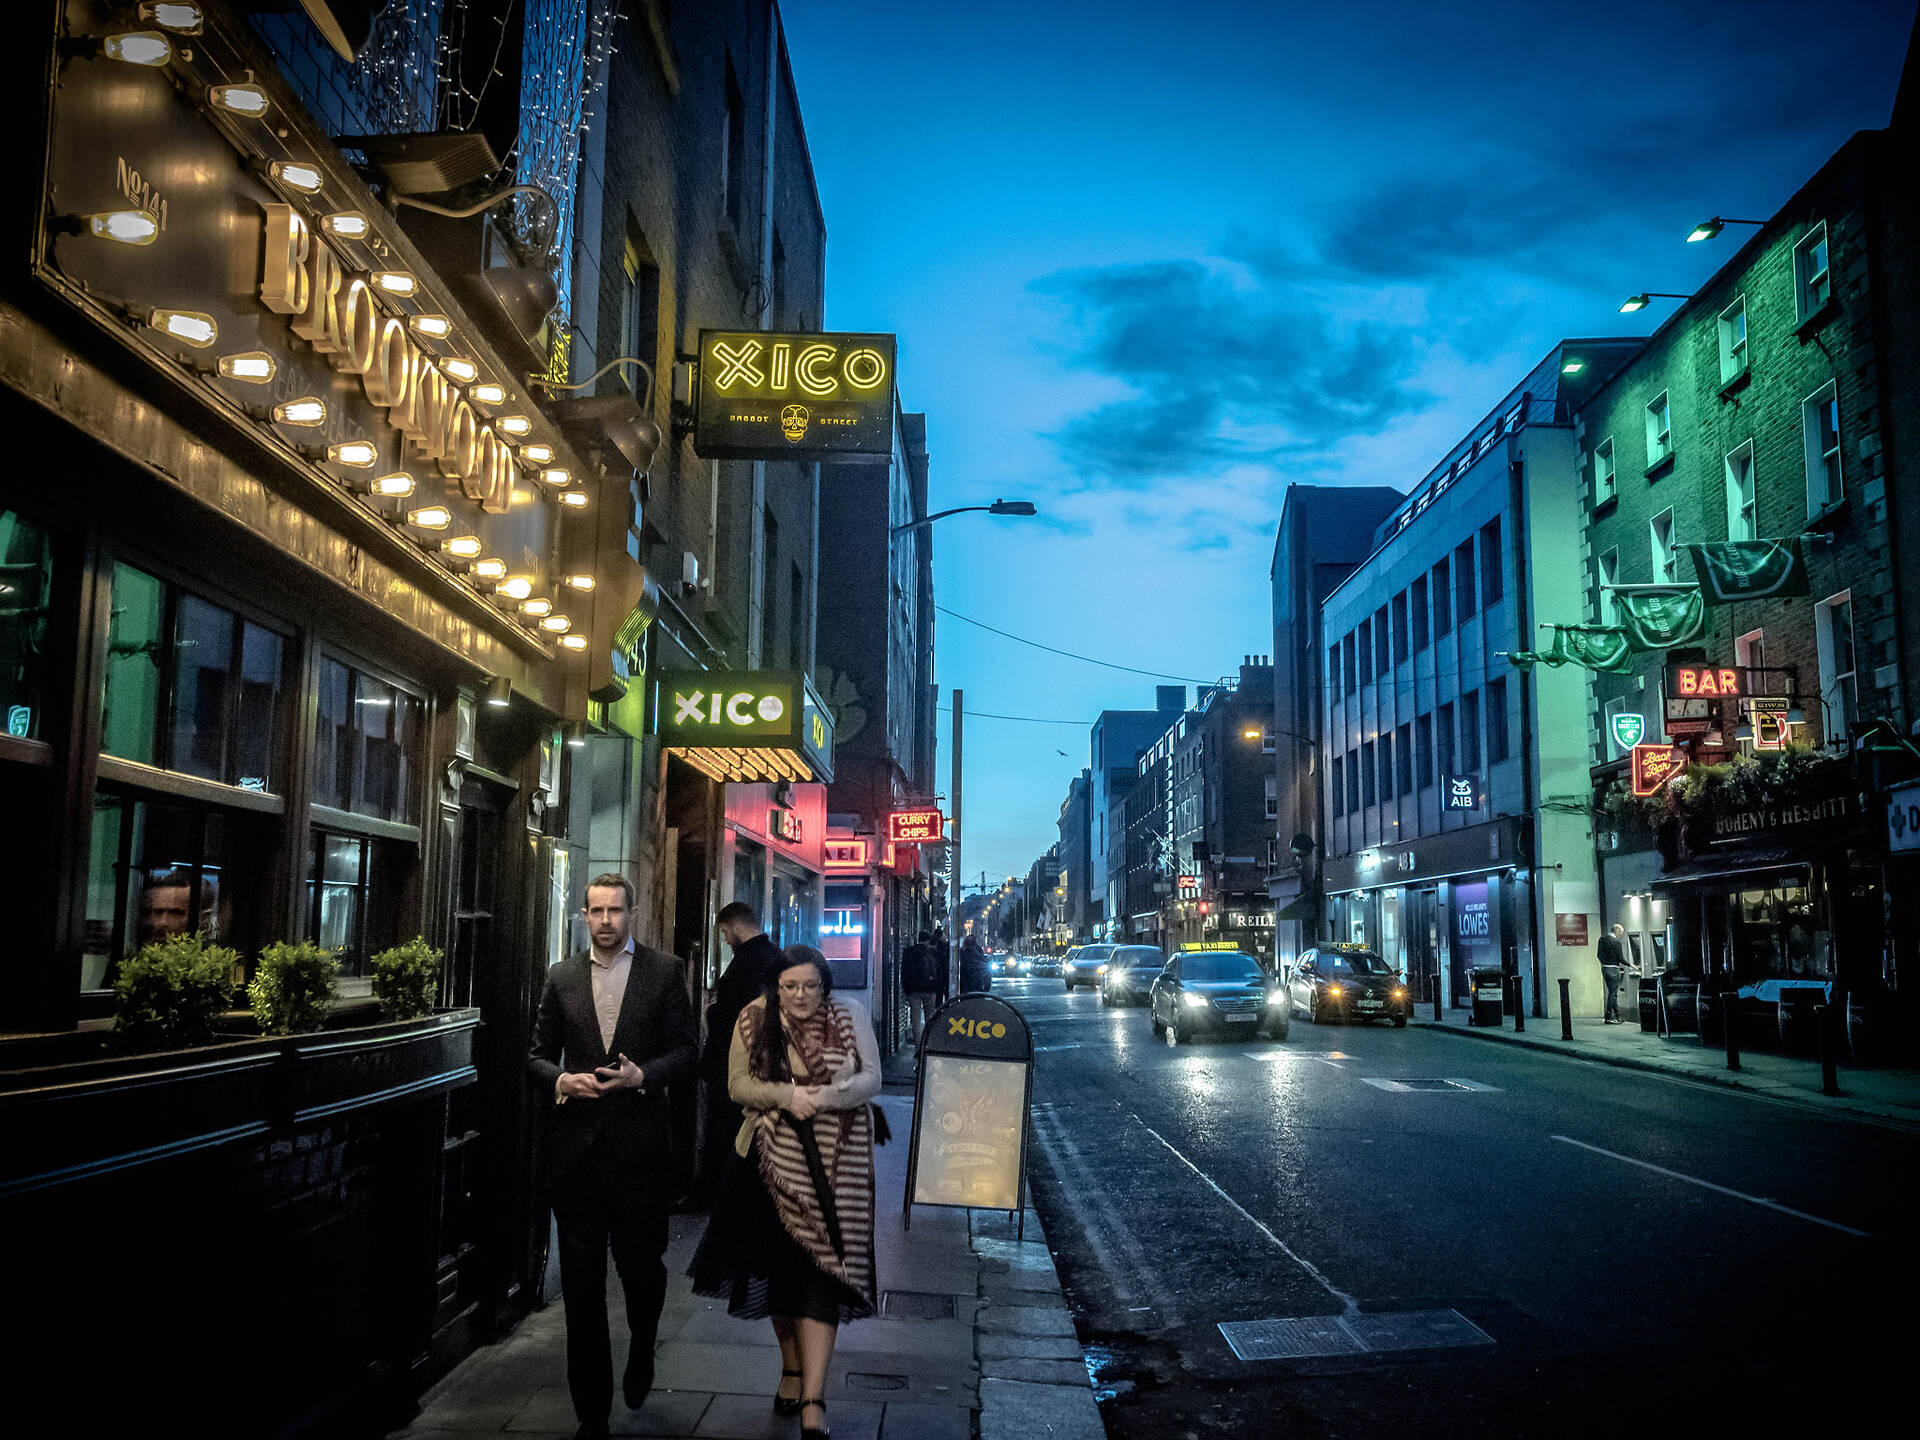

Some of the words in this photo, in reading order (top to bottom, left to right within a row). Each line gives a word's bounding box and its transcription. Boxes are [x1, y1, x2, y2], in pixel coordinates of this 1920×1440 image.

[260, 203, 515, 514] BROOKWOOD
[712, 339, 886, 395] XICO
[1680, 670, 1738, 694] BAR
[674, 690, 784, 725] XICO
[1647, 762, 1672, 777] Bar
[1451, 796, 1473, 807] AIB
[899, 816, 930, 825] CURRY
[900, 827, 929, 837] CHIPS
[948, 1016, 1007, 1039] XICO
